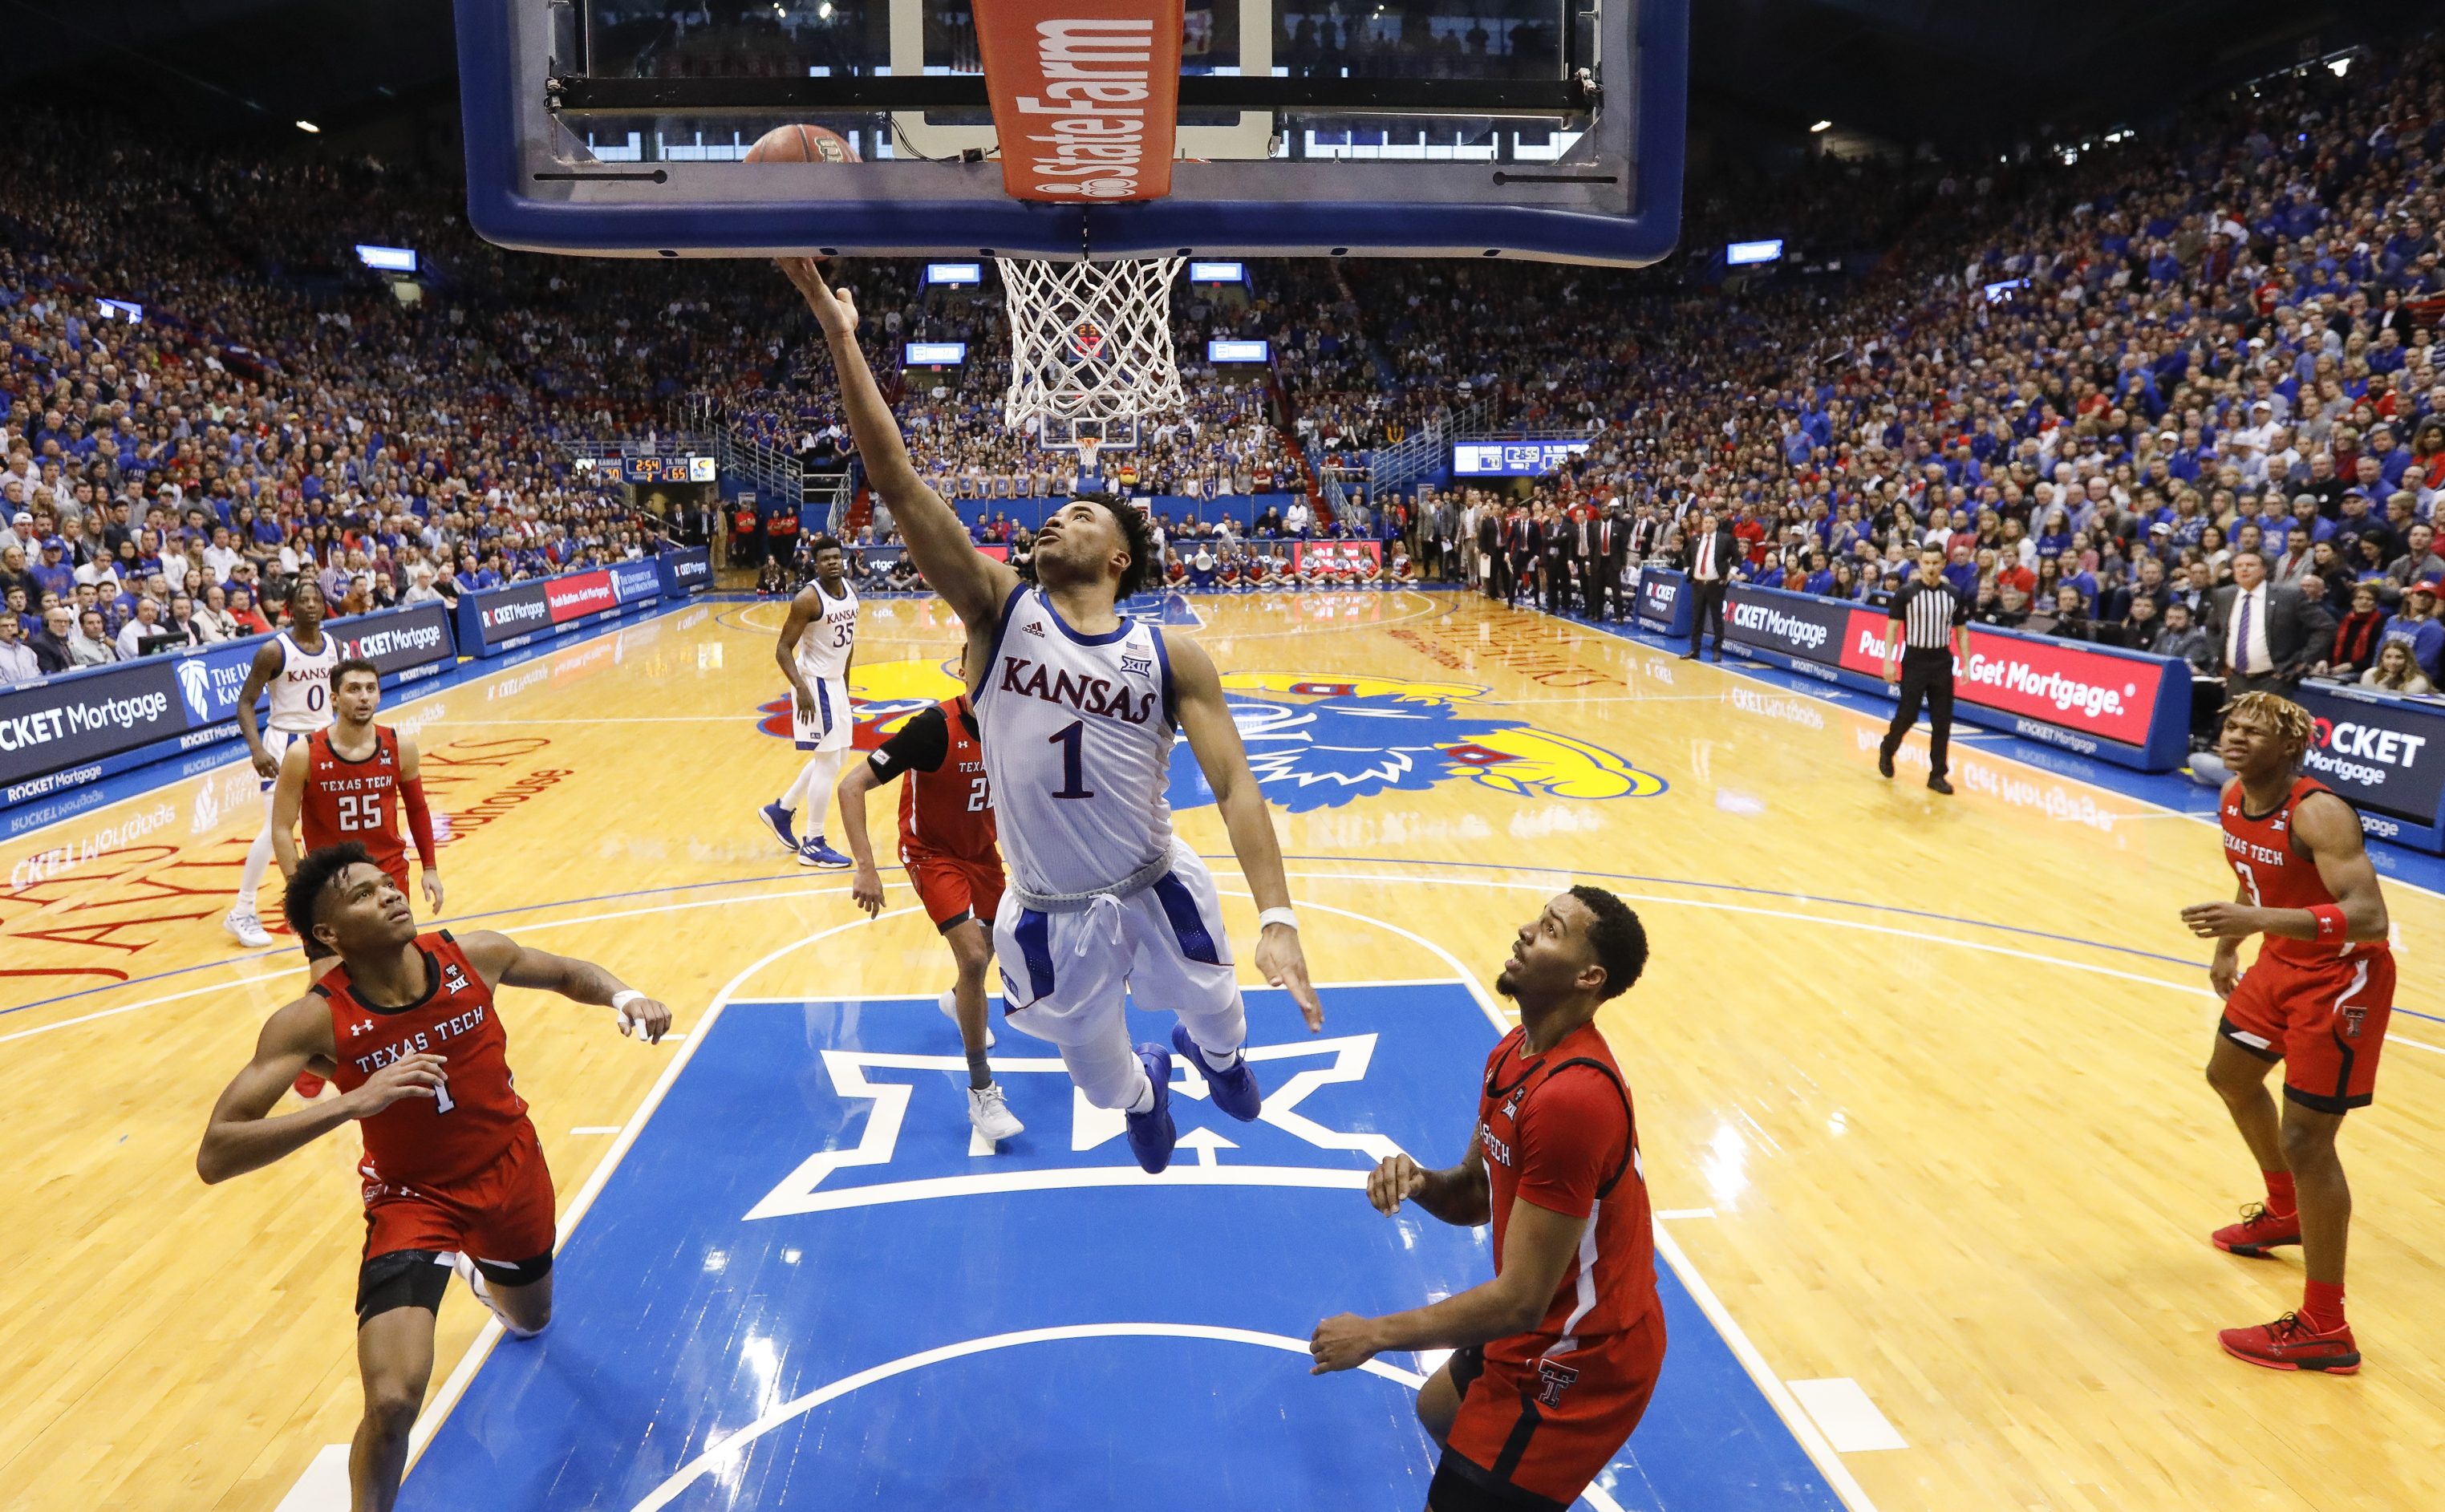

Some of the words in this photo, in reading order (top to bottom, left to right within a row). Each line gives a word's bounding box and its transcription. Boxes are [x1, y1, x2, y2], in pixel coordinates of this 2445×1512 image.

[636, 459, 659, 471] 2:54
[671, 468, 686, 480] 65
[674, 562, 691, 578] ROCKET
[690, 561, 707, 574] Mortgage
[1646, 582, 1677, 602] ROCKET
[482, 605, 514, 628] ROCKET
[514, 601, 545, 621] Mortgage
[1650, 600, 1668, 613] Mortgage
[391, 625, 441, 651] Mortgage
[833, 622, 854, 648] 35
[1021, 625, 1045, 638] adidas
[1766, 607, 1827, 649] Mortgage
[210, 667, 238, 687] THE
[287, 668, 330, 683] KANSA
[1791, 659, 1814, 675] ROCKET
[1814, 663, 1838, 682] Mortgage
[307, 685, 324, 712] 0
[1001, 656, 1157, 724] KANSAS
[1969, 654, 2006, 687] Get
[2005, 660, 2125, 718] Mortgage.
[66, 691, 167, 735] Mortgage
[180, 728, 214, 750] ROCKET
[214, 723, 243, 740] Mortga
[2017, 719, 2054, 743] ROCKET
[2054, 730, 2098, 754] Mortgage
[2309, 716, 2426, 768] OCKET
[959, 762, 986, 772] TEXA
[1049, 720, 1094, 799] 1
[2304, 749, 2386, 785] Mortgage
[7, 776, 55, 803] ROCKET
[55, 764, 103, 788] Mortgage
[320, 778, 362, 792] TEXAS
[366, 776, 392, 790] TECH
[967, 777, 994, 812] 2
[338, 792, 382, 832] 25
[2362, 816, 2399, 837] gage
[2250, 843, 2285, 867] TECH
[355, 1032, 429, 1073] TEXAS
[434, 1006, 484, 1041] TECH
